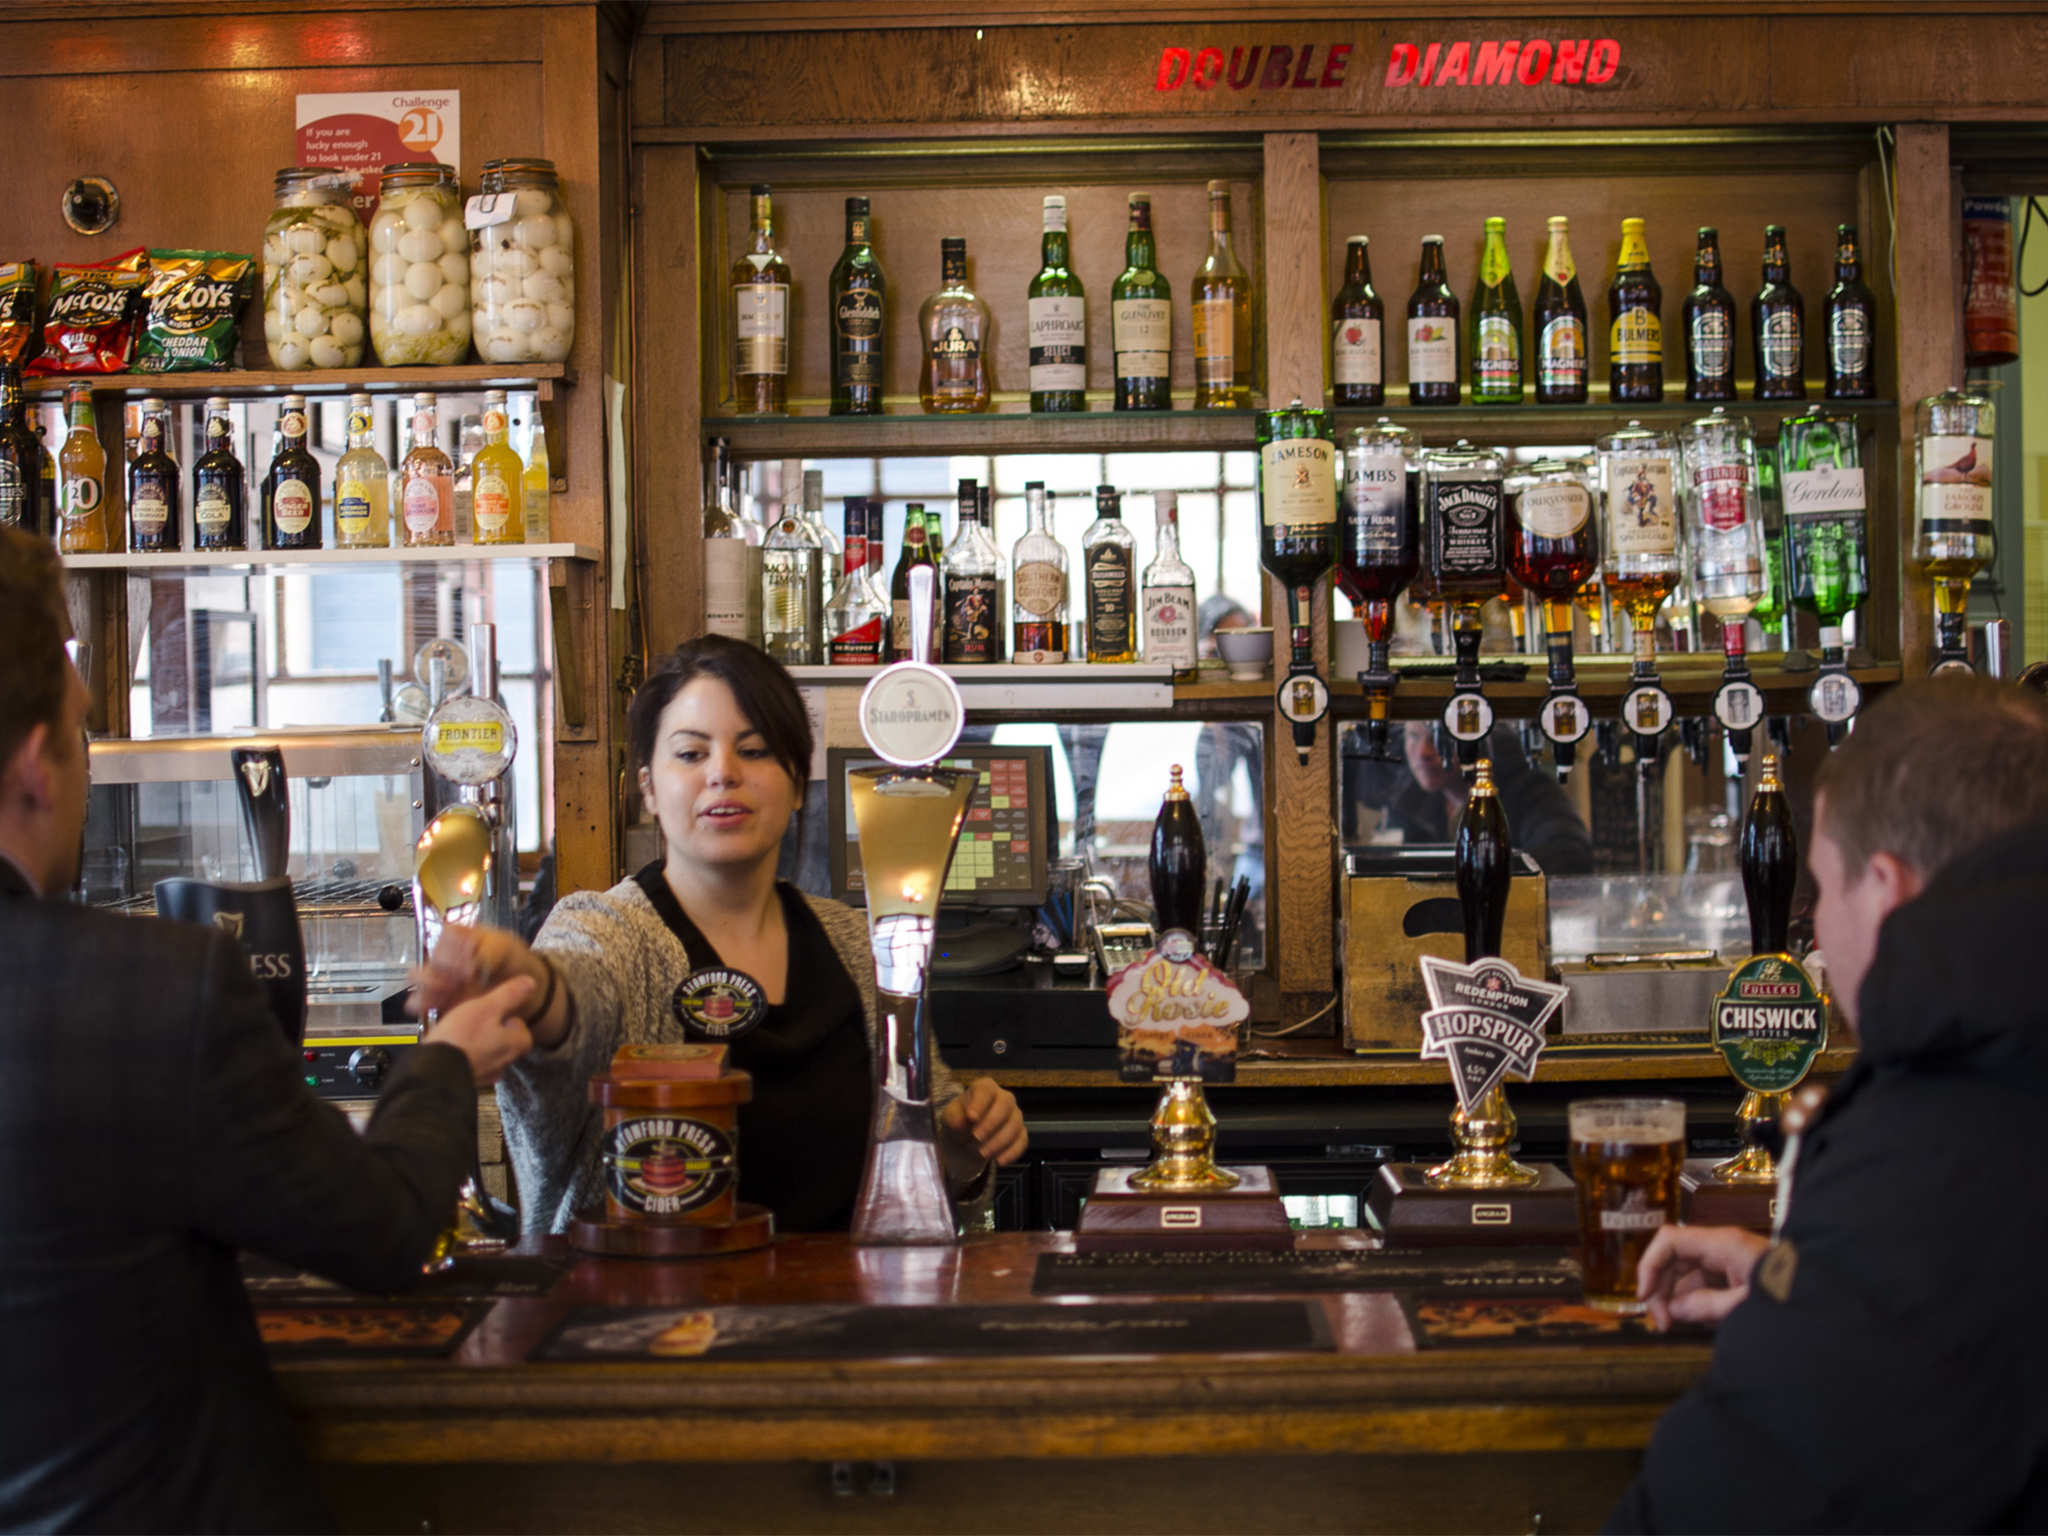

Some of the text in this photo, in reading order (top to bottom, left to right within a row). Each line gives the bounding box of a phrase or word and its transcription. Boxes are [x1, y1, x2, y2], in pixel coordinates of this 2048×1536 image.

[1154, 38, 1622, 92] DOUBLE DIAMOND
[392, 97, 449, 110] Challenge
[306, 127, 351, 139] If you are
[401, 112, 438, 142] 21
[306, 139, 368, 151] lucky enough
[306, 152, 381, 163] to look under 21
[840, 307, 881, 319] Glenfiddich
[1121, 310, 1165, 320] GLENLIVET
[194, 315, 211, 327] CUT
[1031, 319, 1084, 334] LAPHROAIG
[1139, 325, 1149, 334] 12
[1617, 328, 1661, 343] BULMERS
[161, 336, 209, 348] CHEDDAR
[933, 340, 977, 353] JURA
[171, 347, 206, 358] ONION
[1043, 345, 1071, 357] SELECT
[1473, 358, 1520, 370] MAGNERS
[1542, 358, 1588, 370] MAGNERS
[1270, 445, 1328, 465] JAMESON
[1347, 469, 1397, 484] LAMB'S
[1613, 463, 1667, 478] Captain Morgan
[1694, 467, 1747, 484] SMIRNOFF
[1786, 479, 1864, 503] Gordon's
[1945, 493, 1985, 501] FAMOUS
[1438, 487, 1498, 512] JACK DANIEL'S
[1521, 494, 1584, 507] COURVOISIER
[277, 502, 309, 510] GINGER
[1944, 502, 1984, 512] GROUSE
[1348, 515, 1396, 525] NAVY RUM
[1448, 525, 1488, 535] Tennessee
[1449, 538, 1487, 546] WHISKEY
[764, 563, 812, 573] BACARDI
[1016, 572, 1061, 583] SOUTHERN
[1092, 570, 1126, 579] BUSHMILLS
[948, 578, 974, 592] Captain
[1018, 587, 1059, 597] COMFORT
[1104, 603, 1115, 612] 10
[1146, 592, 1190, 611] JIM BEAM
[1150, 627, 1187, 637] BOURBON
[964, 644, 985, 653] RUM
[870, 708, 951, 724] STAROPRAMEN
[438, 728, 498, 741] FRONTIER
[682, 971, 757, 998] STOWFORD PRESS
[1140, 959, 1209, 998] Old
[1454, 982, 1529, 1008] REDEMPTION
[1124, 986, 1229, 1026] Rosie
[1471, 997, 1509, 1010] LONDON
[1720, 1006, 1817, 1030] CHISWICK
[705, 1022, 730, 1036] CIDER
[1434, 1012, 1535, 1058] HOPSPUR
[1747, 1029, 1790, 1037] BITTER
[1464, 1063, 1488, 1075] 4.5%
[614, 1119, 717, 1154] STOWFORD PRESS
[644, 1195, 681, 1213] CIDER
